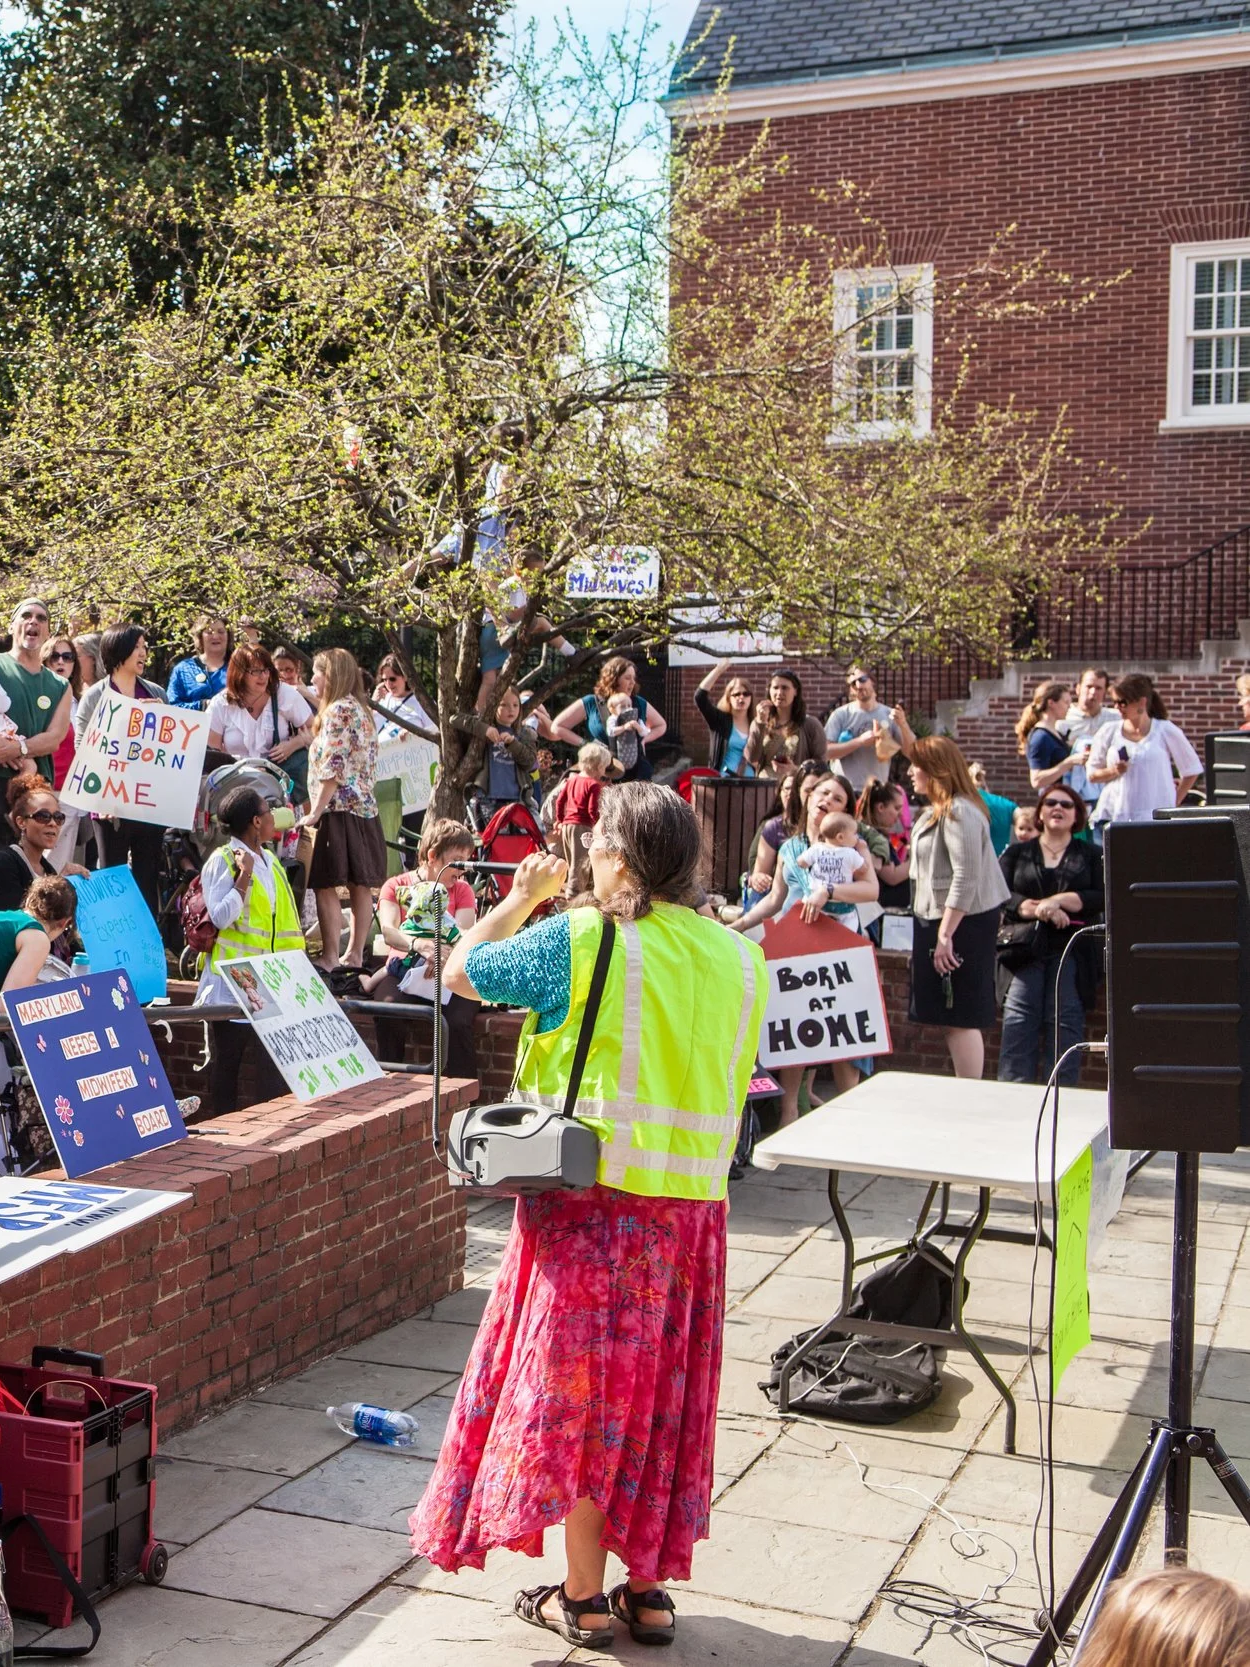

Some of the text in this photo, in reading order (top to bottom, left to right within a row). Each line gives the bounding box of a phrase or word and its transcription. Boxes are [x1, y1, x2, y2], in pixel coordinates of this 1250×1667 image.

[127, 707, 201, 751] BABY
[86, 729, 185, 770] WAS BORN
[108, 759, 129, 772] AT
[68, 764, 156, 807] HOME
[113, 949, 131, 966] In
[776, 960, 854, 993] BORN
[17, 992, 83, 1024] MARYLAND
[808, 996, 836, 1012] AT
[61, 1029, 118, 1059] NEEDS A
[768, 1009, 877, 1052] HOME
[78, 1067, 136, 1100] MIDWIFERY
[322, 1063, 339, 1088] A
[337, 1052, 365, 1078] TUB
[134, 1108, 171, 1136] BOARD
